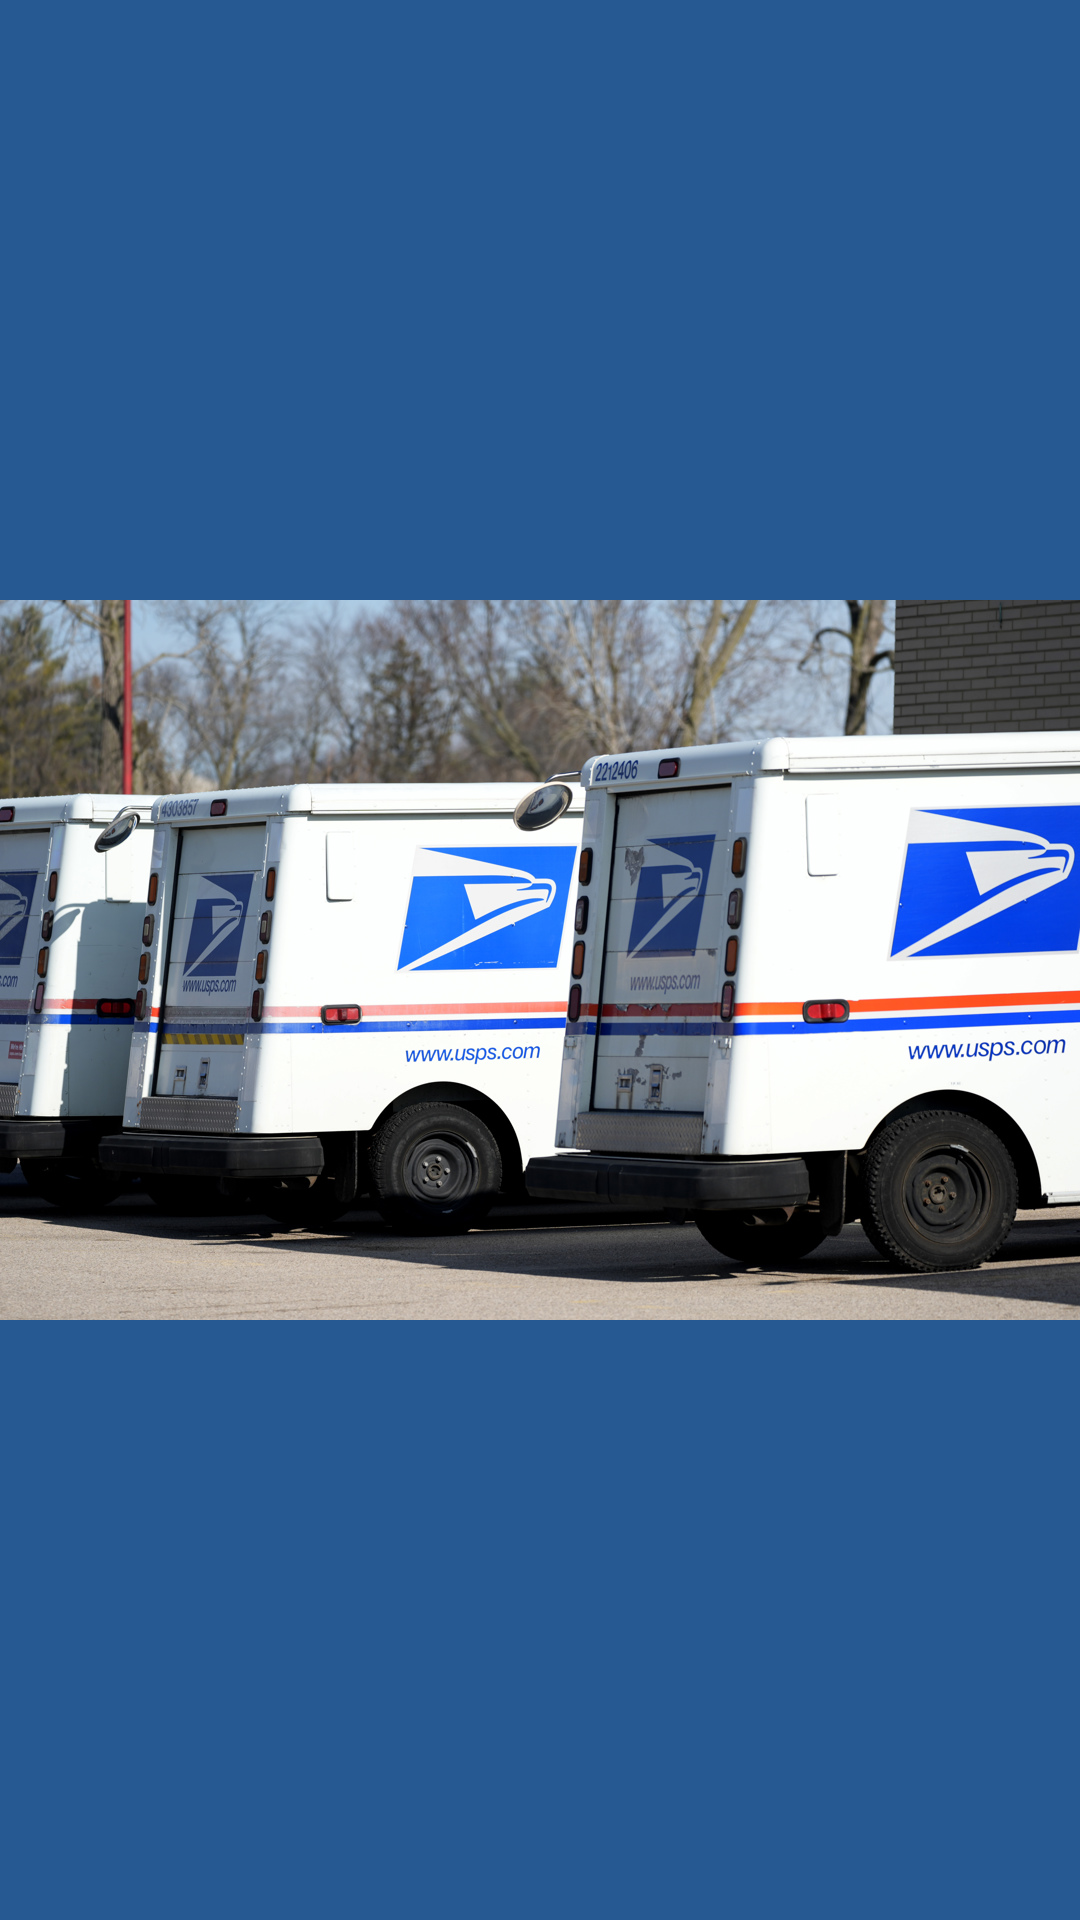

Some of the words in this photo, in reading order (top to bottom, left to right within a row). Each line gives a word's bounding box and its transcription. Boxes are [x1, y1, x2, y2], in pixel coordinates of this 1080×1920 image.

[595, 760, 639, 781] 2212406
[162, 799, 199, 817] 4303857
[0, 975, 18, 987] .com
[182, 979, 237, 996] www.usps.com
[630, 974, 701, 995] www.usps.com
[405, 1045, 541, 1064] www.usps.com
[908, 1038, 1066, 1061] www.usps.com
